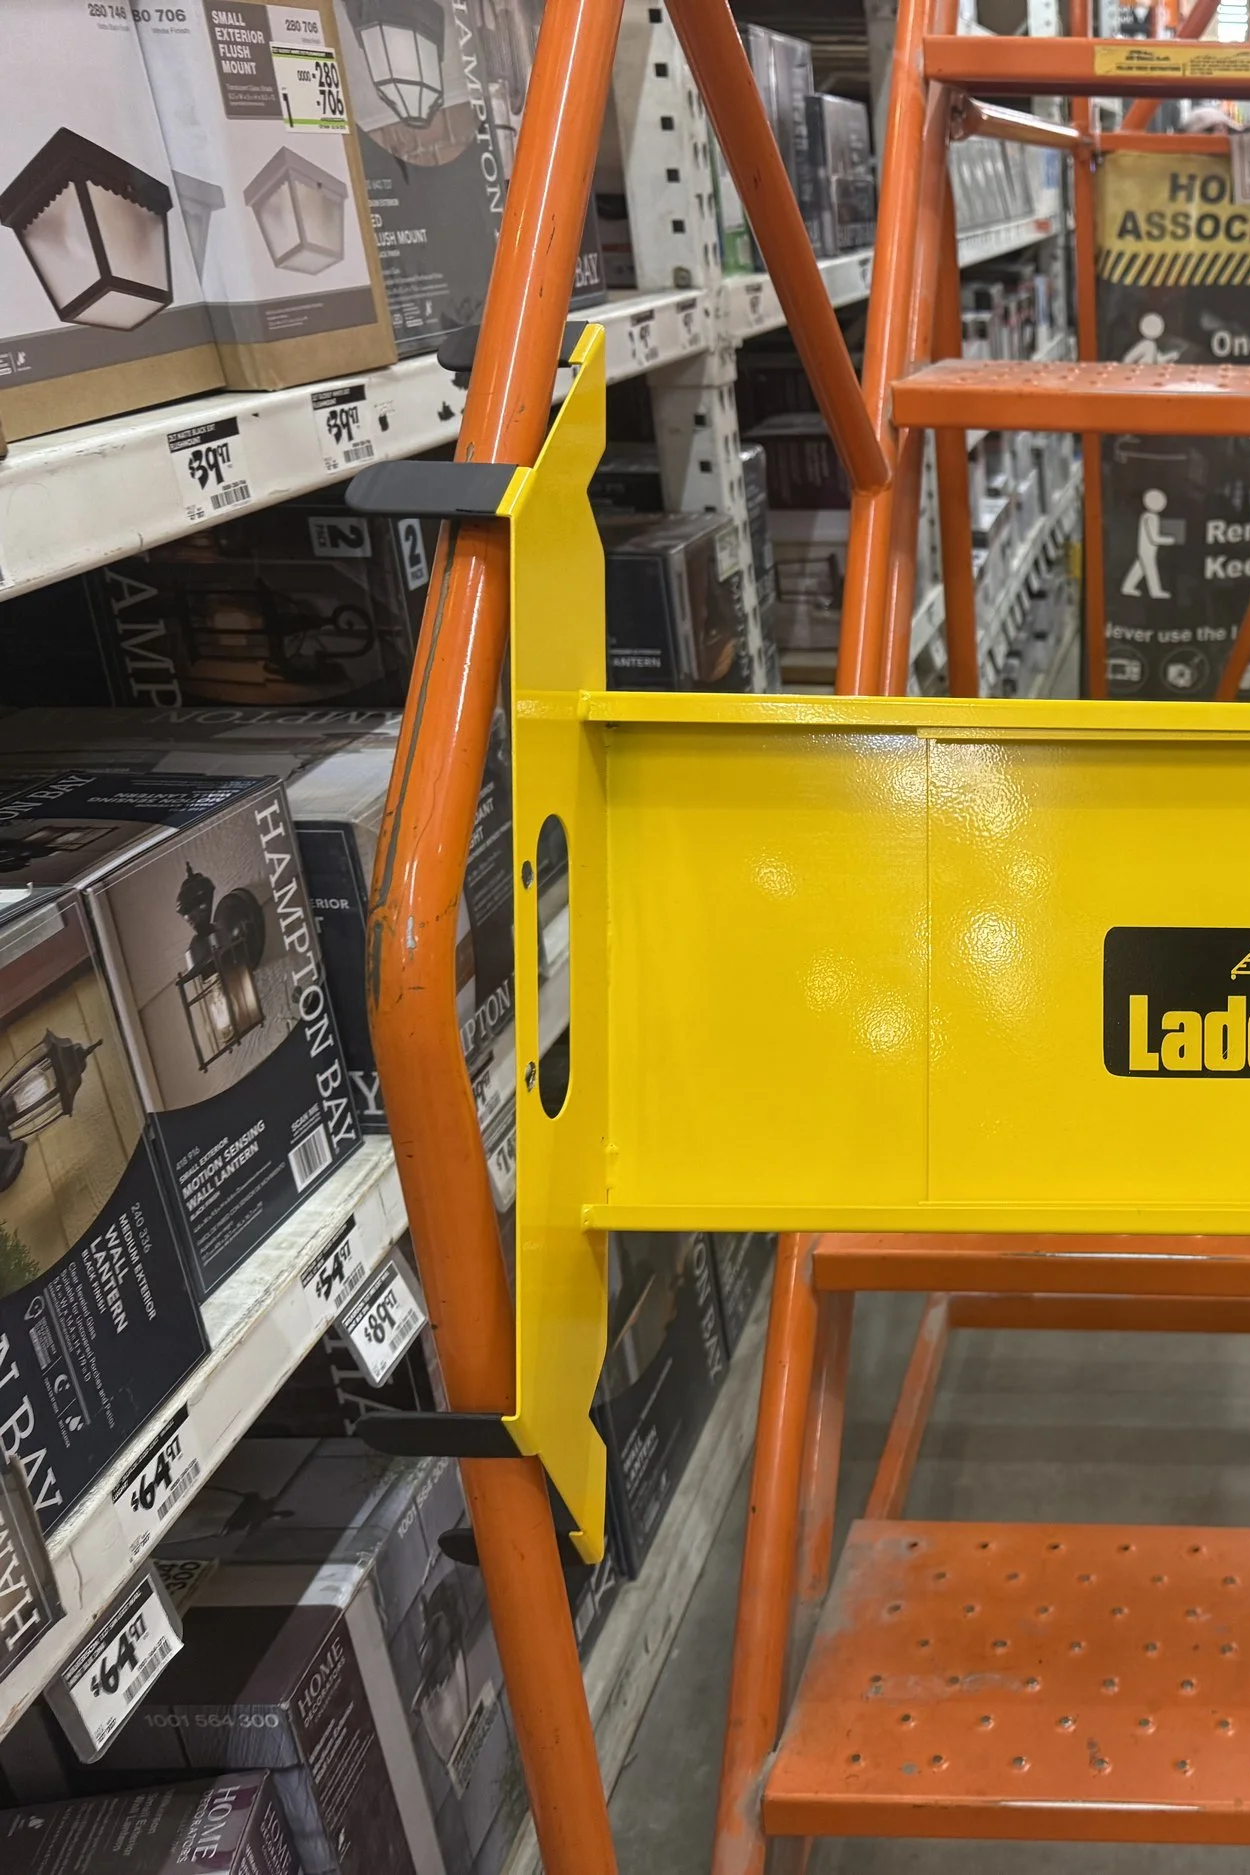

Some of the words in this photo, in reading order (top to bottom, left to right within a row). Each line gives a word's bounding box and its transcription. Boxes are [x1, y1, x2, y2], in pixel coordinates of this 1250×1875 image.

[155, 9, 187, 22] 706
[212, 10, 246, 27] SMALL
[215, 27, 265, 44] EXTERIOR
[284, 19, 301, 32] 280
[302, 20, 319, 33] 706
[219, 44, 251, 60] FLUSH
[222, 61, 257, 76] MOUNT
[1168, 172, 1235, 204] HO
[403, 524, 422, 569] 2
[1158, 628, 1191, 642] use
[1196, 623, 1228, 642] the
[29, 774, 98, 800] BAY
[254, 799, 335, 1058] HAMPTON
[315, 1063, 357, 1153] BAY
[290, 1112, 308, 1132] SCAN
[178, 1161, 200, 1184] SMALL
[198, 1135, 228, 1166] EXTERIOR
[182, 1155, 223, 1199] MOTION
[222, 1118, 266, 1162] SENSING
[186, 1181, 214, 1212] WALL
[214, 1140, 259, 1187] LANTERN
[130, 1202, 146, 1233] 240
[104, 1222, 132, 1285] WALL
[118, 1212, 140, 1265] MEDIUM
[133, 1262, 157, 1321] EXTERIOR
[81, 1248, 96, 1282] BLACK
[92, 1280, 107, 1314] FINISH
[89, 1234, 129, 1334] LANTERN
[297, 1636, 345, 1718] HOME
[303, 1656, 348, 1728] DECORATORS
[143, 1713, 190, 1729] 1001
[196, 1713, 234, 1728] 564
[238, 1712, 280, 1729] 300
[177, 1789, 214, 1864] DECORATORS
[191, 1785, 241, 1862] HOME
